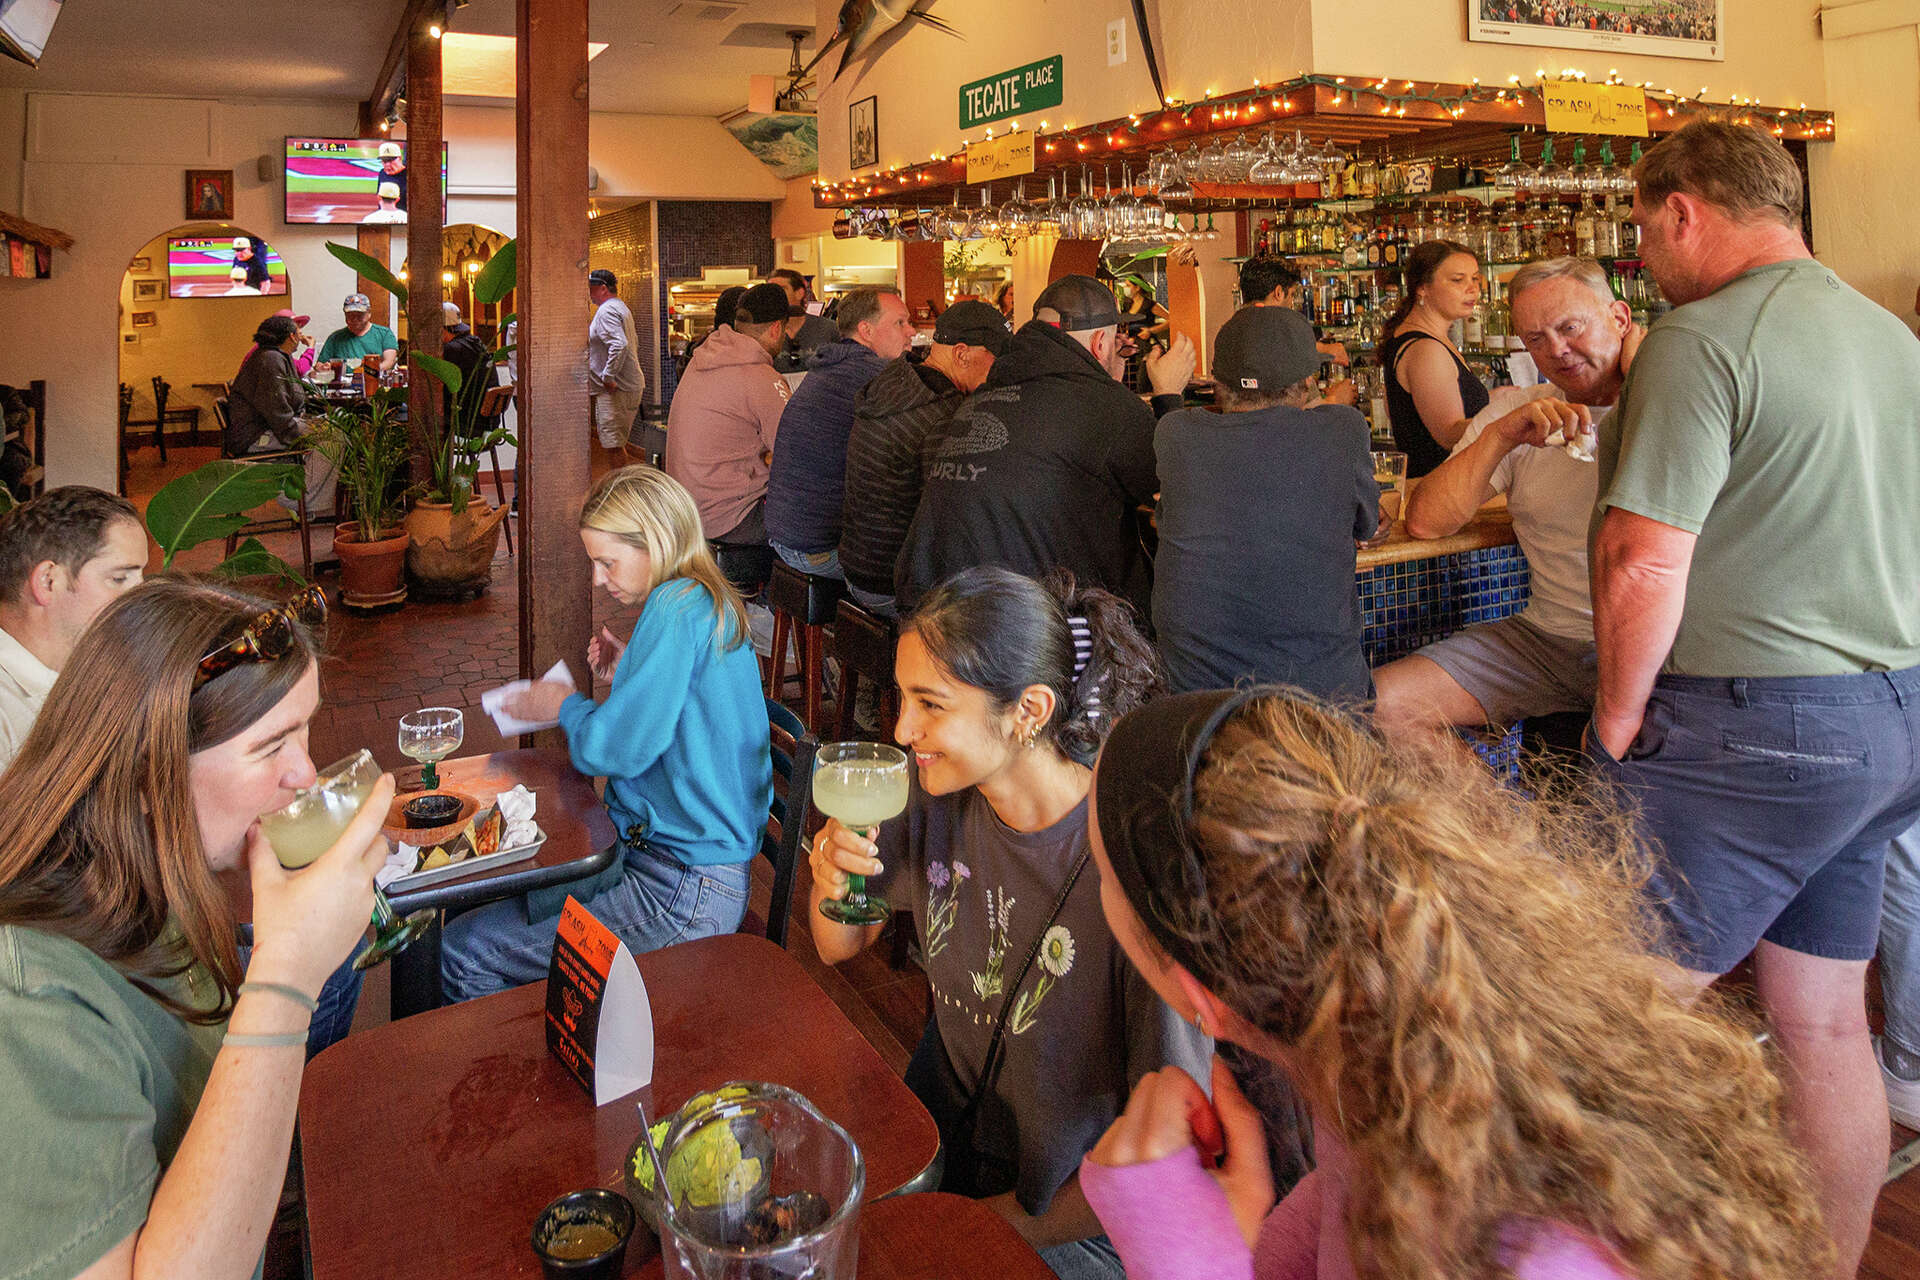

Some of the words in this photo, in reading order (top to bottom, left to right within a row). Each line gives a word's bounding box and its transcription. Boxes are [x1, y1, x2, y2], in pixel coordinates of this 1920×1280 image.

[966, 75, 1020, 121] TECATE
[1025, 64, 1054, 90] PLACE
[1548, 98, 1592, 113] SPLASH
[1616, 103, 1644, 117] ZONE
